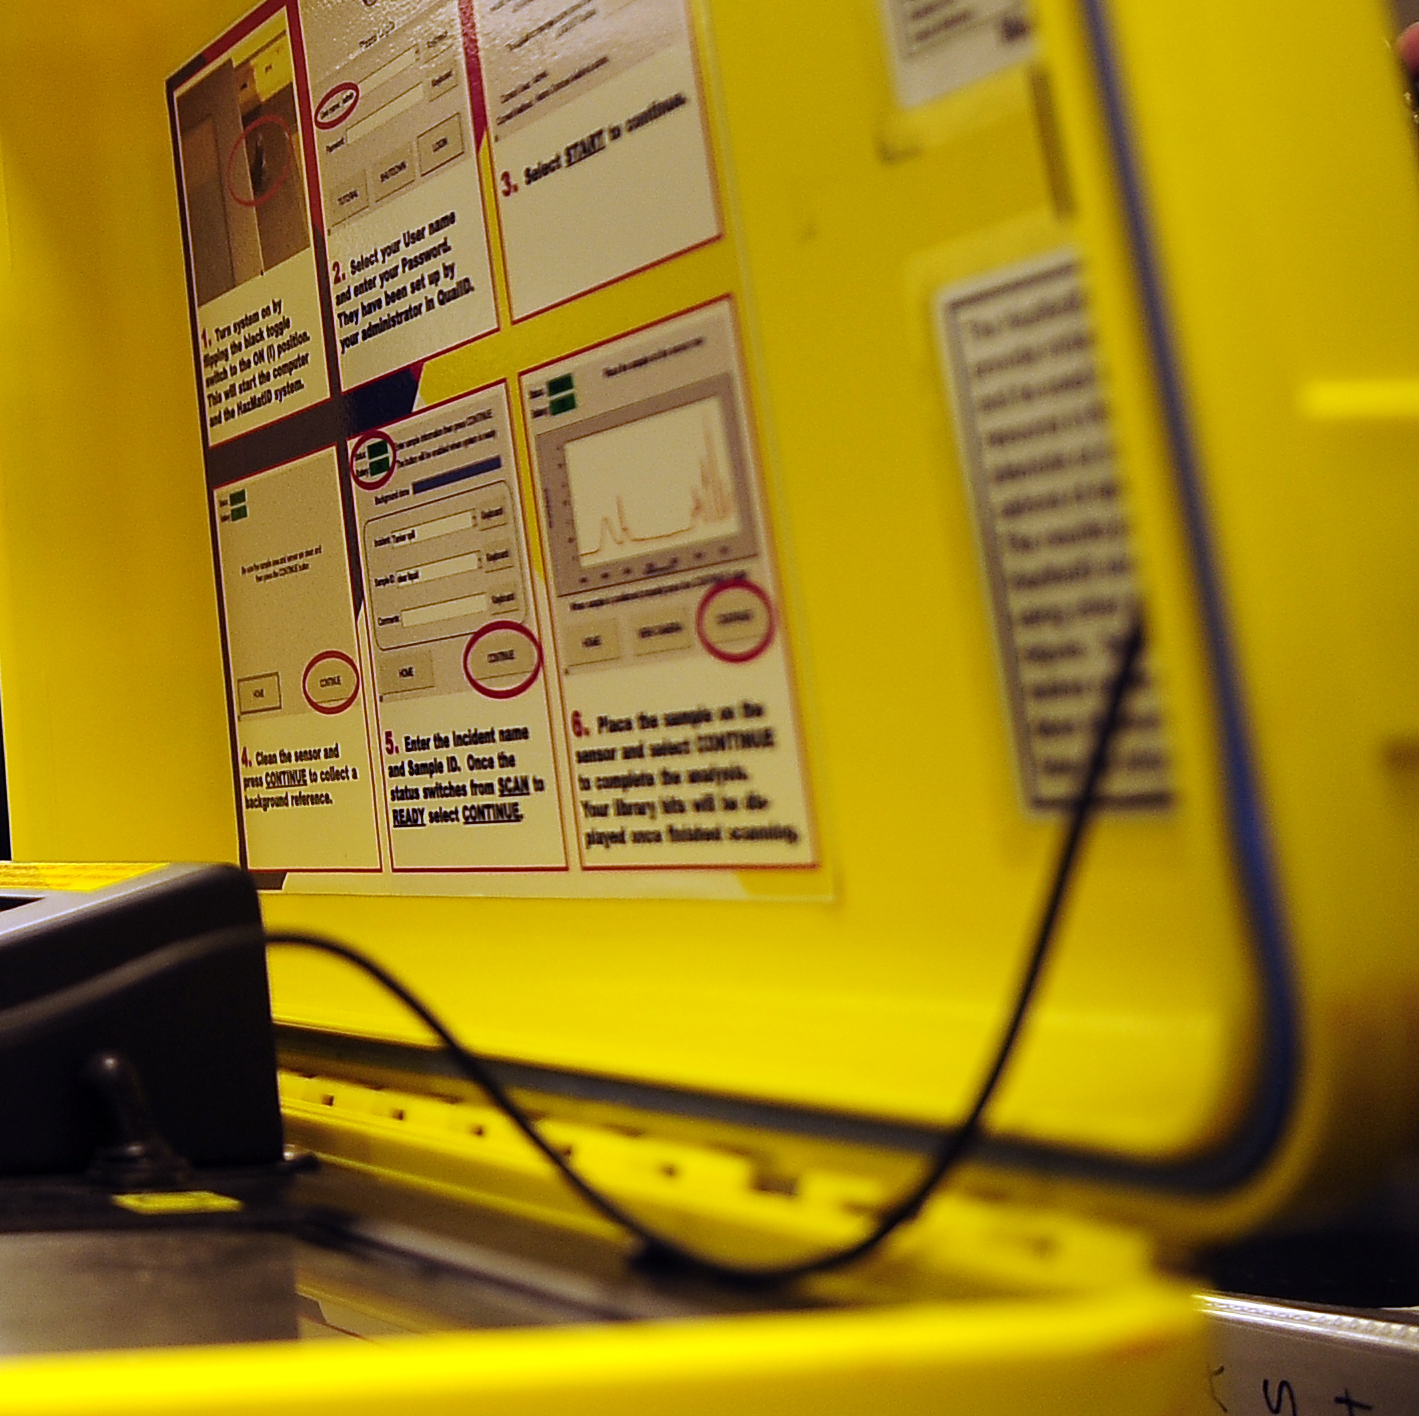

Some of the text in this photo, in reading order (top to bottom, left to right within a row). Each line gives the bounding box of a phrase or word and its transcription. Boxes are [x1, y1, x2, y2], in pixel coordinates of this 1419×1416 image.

[501, 171, 519, 197] 3.
[524, 153, 561, 185] Select
[565, 129, 606, 168] START
[609, 125, 621, 141] to
[332, 211, 456, 284] 2. Select your User name
[335, 236, 452, 306] and enter your Password.
[337, 262, 456, 328] They have been set up by
[201, 299, 282, 349] 1. Turn system on by
[230, 341, 242, 355] the
[244, 327, 265, 349] black
[266, 315, 290, 338] toggle
[340, 332, 359, 354] your
[361, 302, 423, 341] administrator
[424, 295, 435, 312] in
[206, 368, 228, 387] switch
[229, 364, 237, 377] to
[239, 358, 251, 372] the
[253, 348, 265, 366] ON
[277, 331, 310, 358] position.
[207, 353, 309, 407] This will start the computer
[210, 410, 222, 427] and
[224, 406, 235, 421] the
[274, 379, 304, 402] system.
[571, 710, 590, 737] 6.
[597, 715, 633, 734] Place
[638, 712, 658, 730] the
[664, 707, 712, 728] sample
[241, 742, 340, 768] 4. Clean the sensor and
[385, 731, 399, 755] 5.
[404, 735, 431, 753] Enter
[433, 732, 450, 750] the
[499, 726, 530, 742] name
[576, 747, 616, 764] sensor
[622, 741, 644, 760] and
[650, 739, 690, 758] select
[243, 765, 358, 791] press CONTINUE to collect a
[388, 751, 516, 778] and Sample ID. Once the
[579, 775, 591, 791] to
[596, 770, 655, 790] complete
[661, 767, 681, 786] the
[245, 791, 333, 812] background reference.
[390, 775, 545, 802] status switches from SCAN to
[392, 801, 524, 828] READY select CONTINUE.
[581, 800, 609, 818] Your
[616, 799, 655, 820] library
[586, 827, 626, 849] played
[632, 830, 662, 844] once
